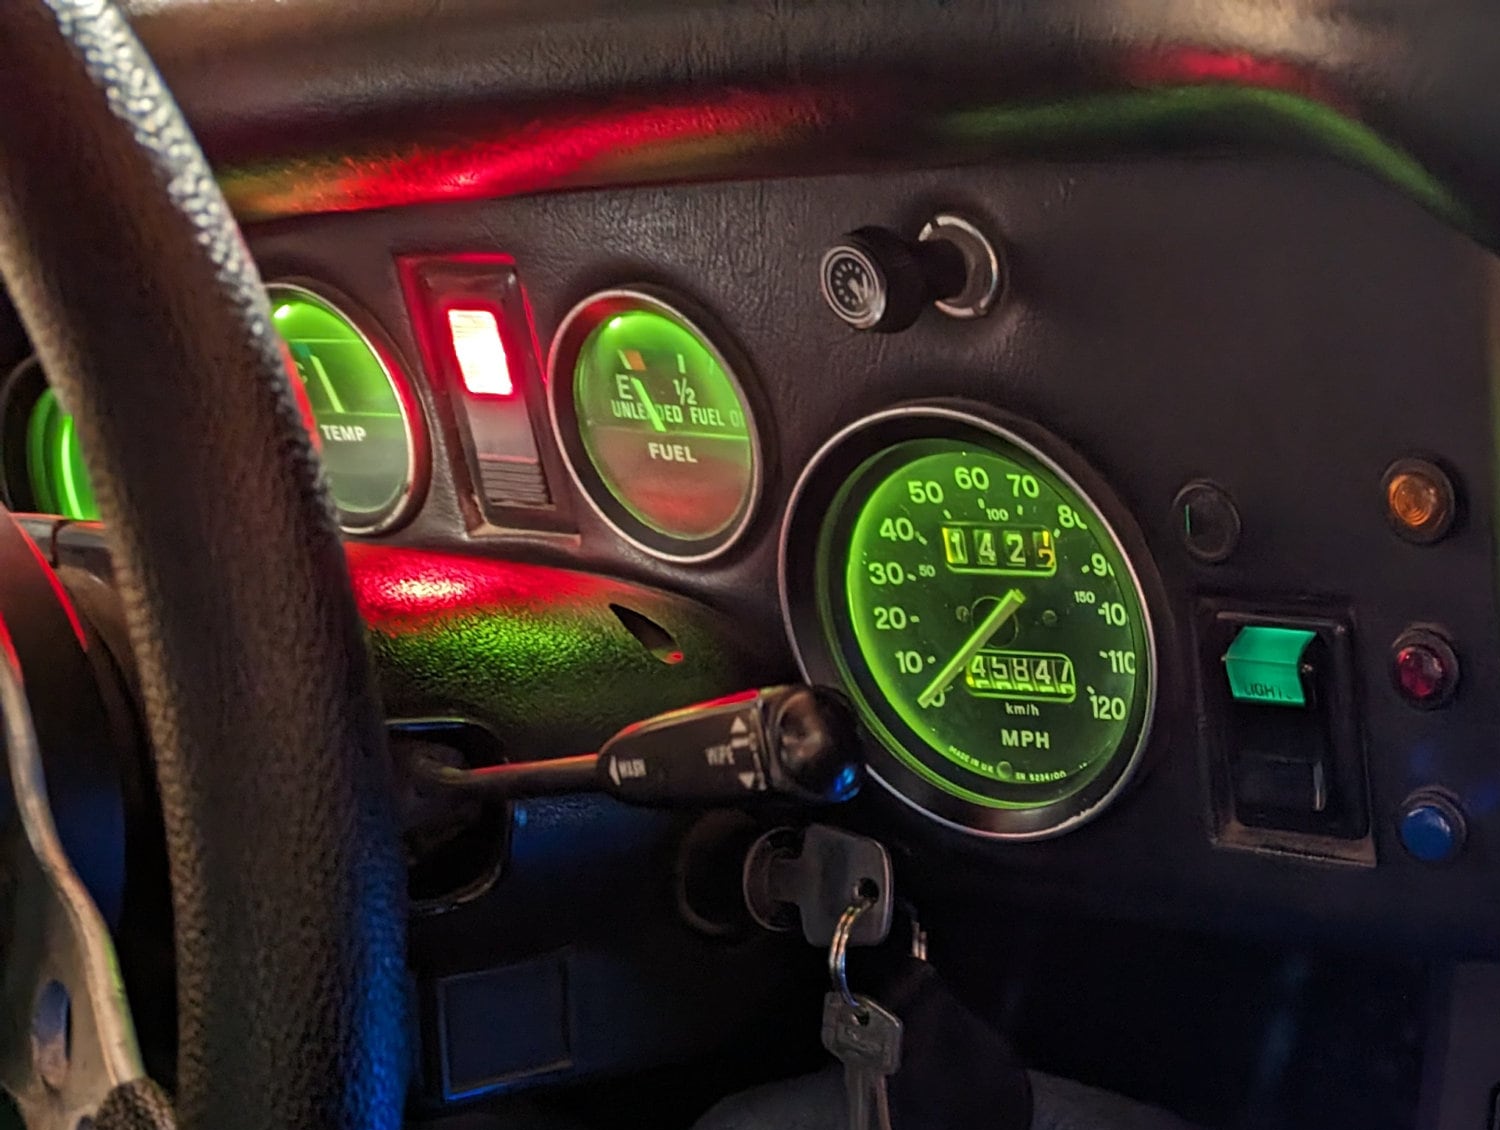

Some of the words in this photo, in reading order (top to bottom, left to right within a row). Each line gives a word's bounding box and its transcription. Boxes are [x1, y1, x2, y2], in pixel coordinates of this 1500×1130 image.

[616, 373, 633, 400] E
[611, 400, 684, 424] UNLEDED
[691, 407, 725, 427] FUEL
[320, 424, 367, 442] TEMP
[648, 442, 698, 463] FUEL
[955, 466, 990, 490] 60
[1006, 474, 1039, 498] 70
[908, 480, 944, 504] 50
[986, 508, 1009, 521] 100
[880, 517, 914, 541] 40
[868, 562, 904, 585] 30
[918, 564, 936, 578] 50
[1074, 590, 1096, 604] 150
[874, 606, 907, 630] 20
[895, 651, 923, 674] 10
[1005, 702, 1040, 717] km/h
[1089, 695, 1126, 721] 120
[1001, 728, 1050, 749] MPH
